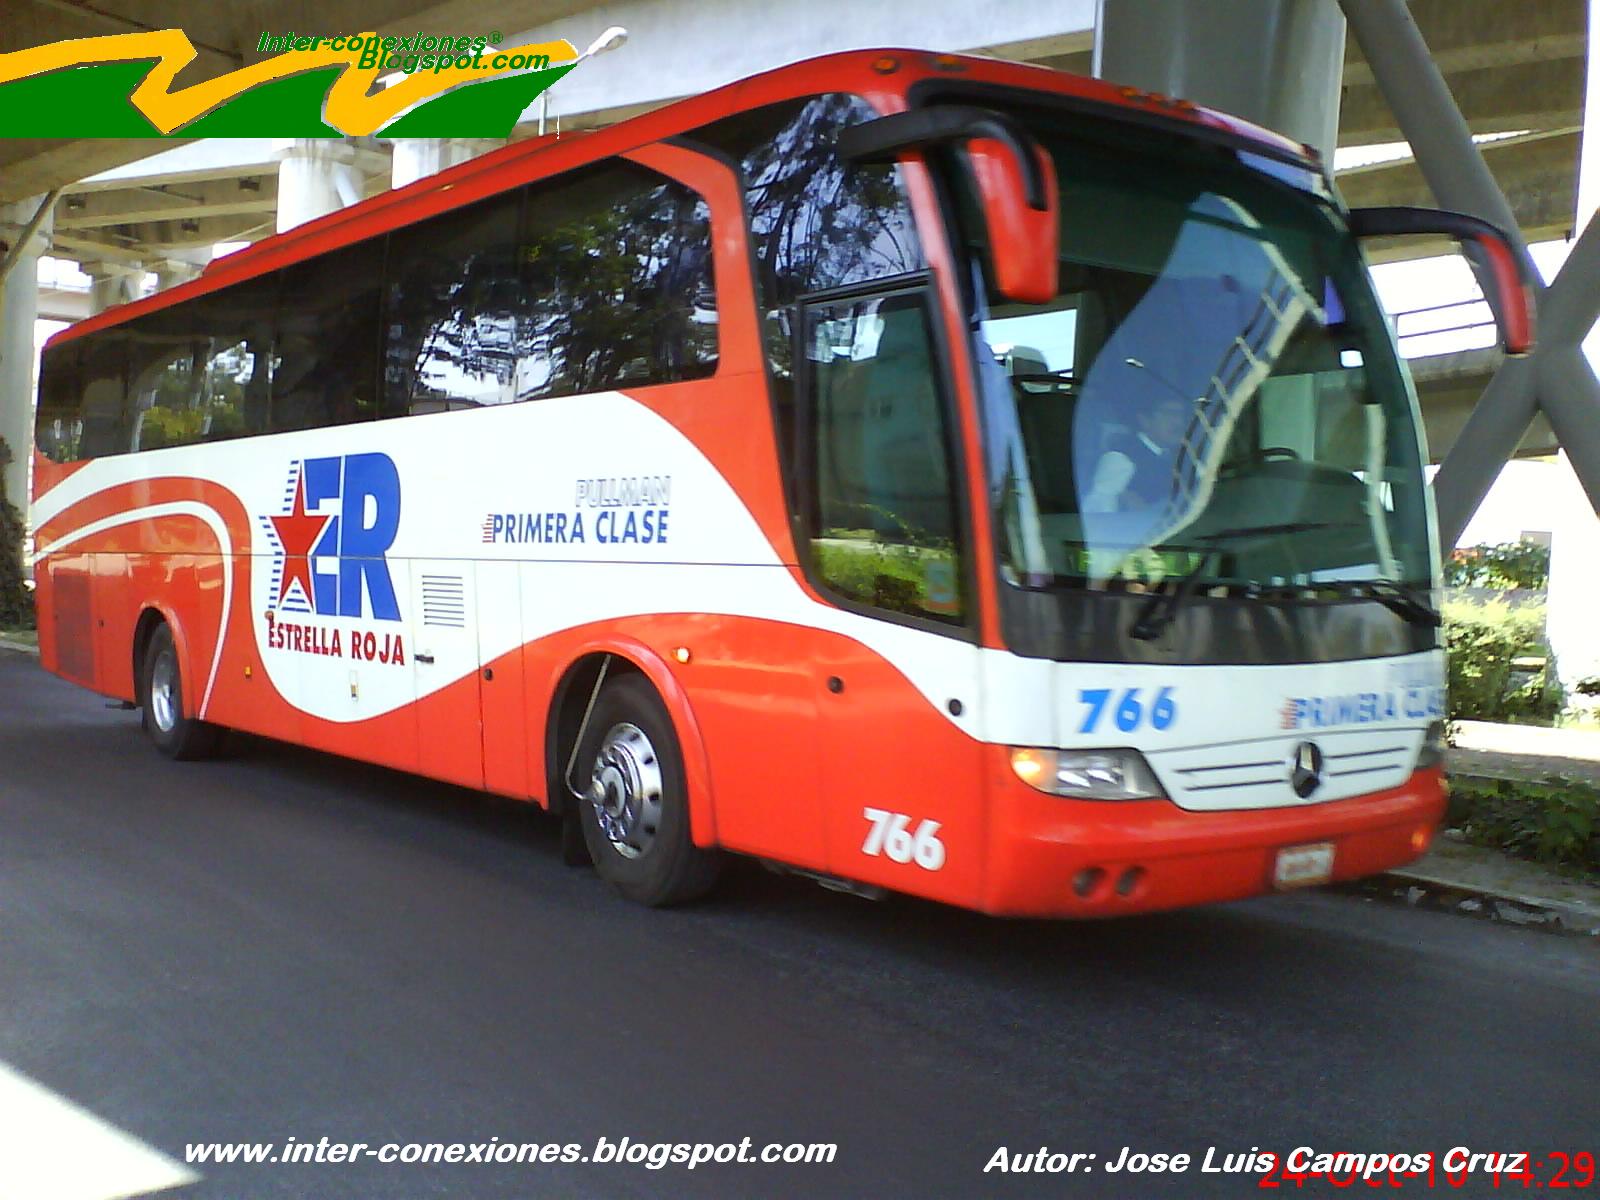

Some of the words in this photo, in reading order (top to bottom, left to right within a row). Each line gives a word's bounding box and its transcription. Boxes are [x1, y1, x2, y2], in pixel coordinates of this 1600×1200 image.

[575, 475, 671, 508] PULLMAN
[491, 512, 586, 544] PRIMERA
[595, 510, 670, 544] CLASE
[268, 622, 343, 658] ESTRELLA
[351, 630, 405, 667] ROJA
[1077, 687, 1177, 734] 766
[1294, 692, 1397, 729] PRIMERA
[862, 807, 946, 872] 766
